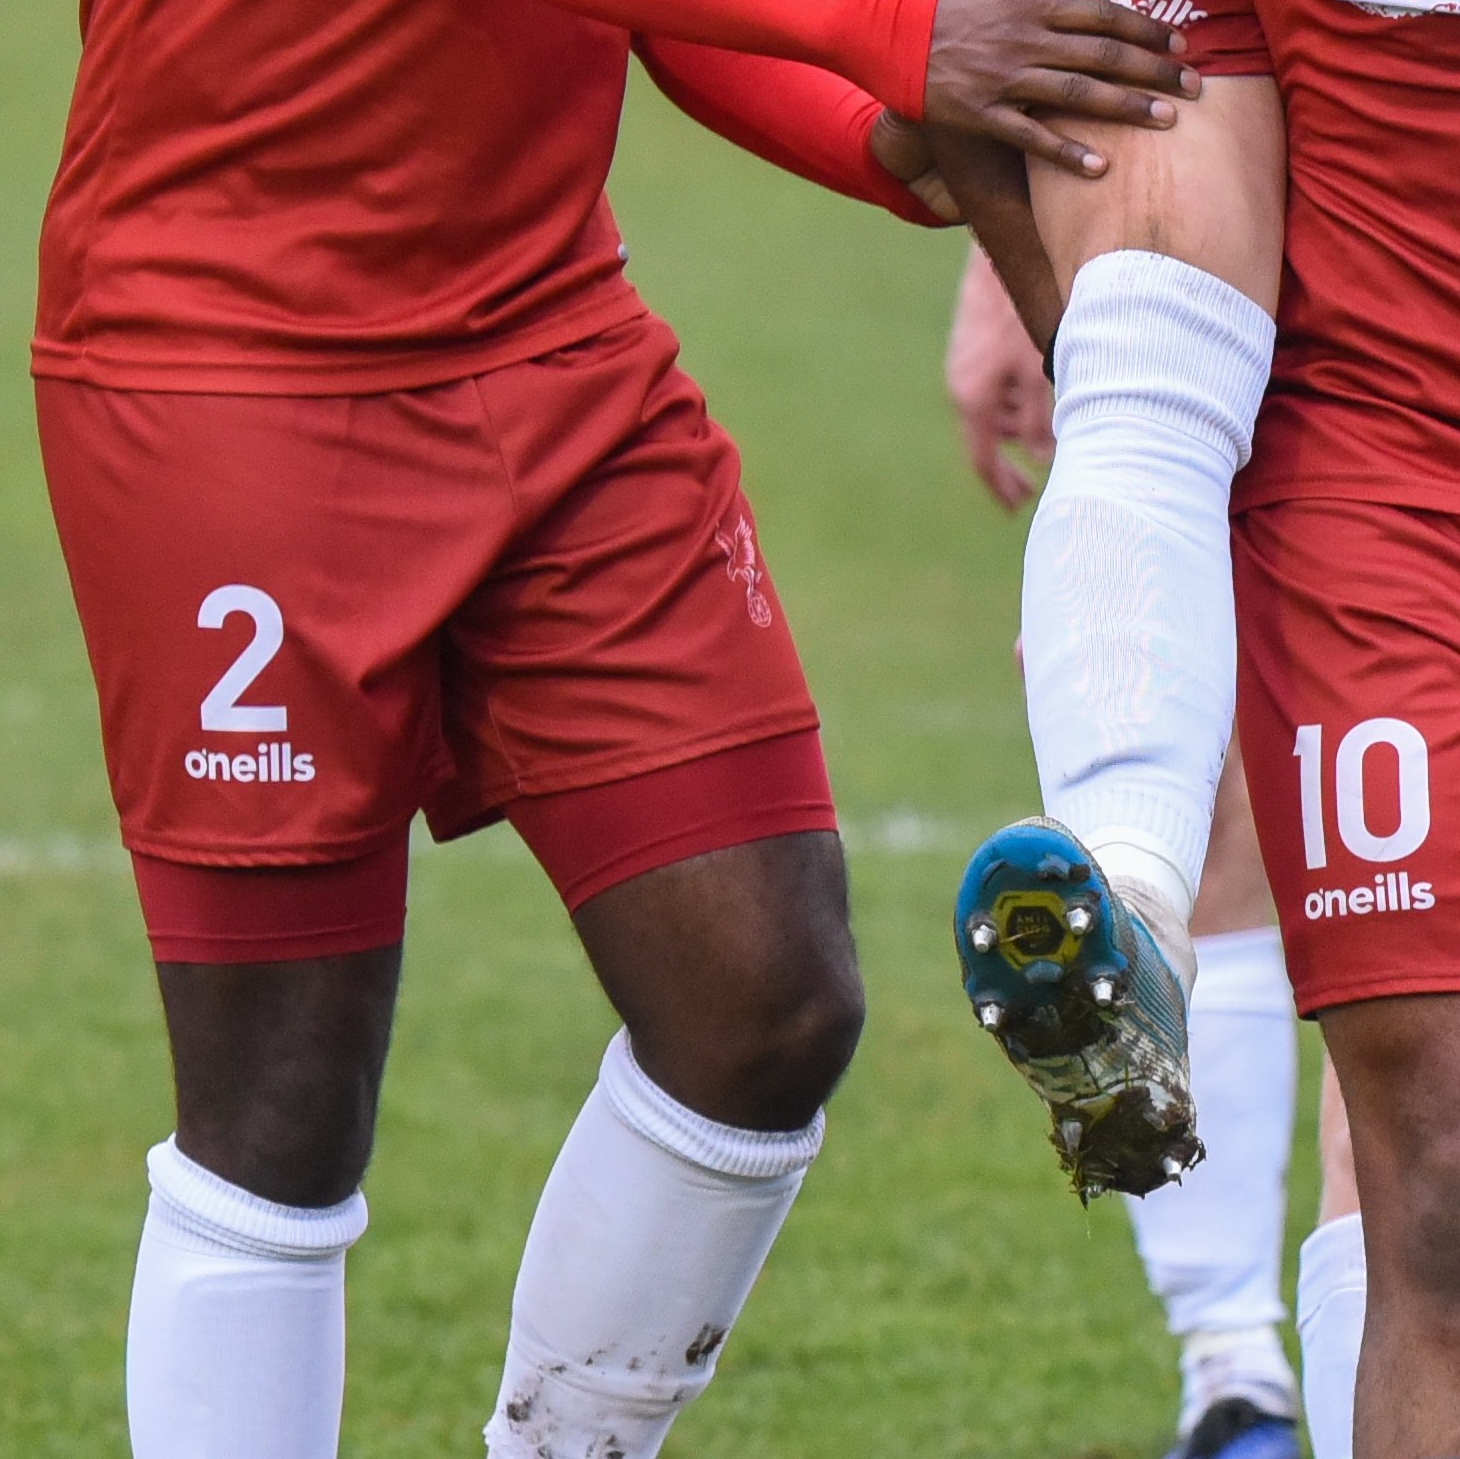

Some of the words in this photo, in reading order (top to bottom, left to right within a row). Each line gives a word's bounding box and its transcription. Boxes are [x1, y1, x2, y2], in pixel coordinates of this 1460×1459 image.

[196, 583, 289, 732] 2
[184, 741, 316, 783] o'neills
[1291, 716, 1431, 870] 10
[1303, 870, 1436, 921] o'neills
